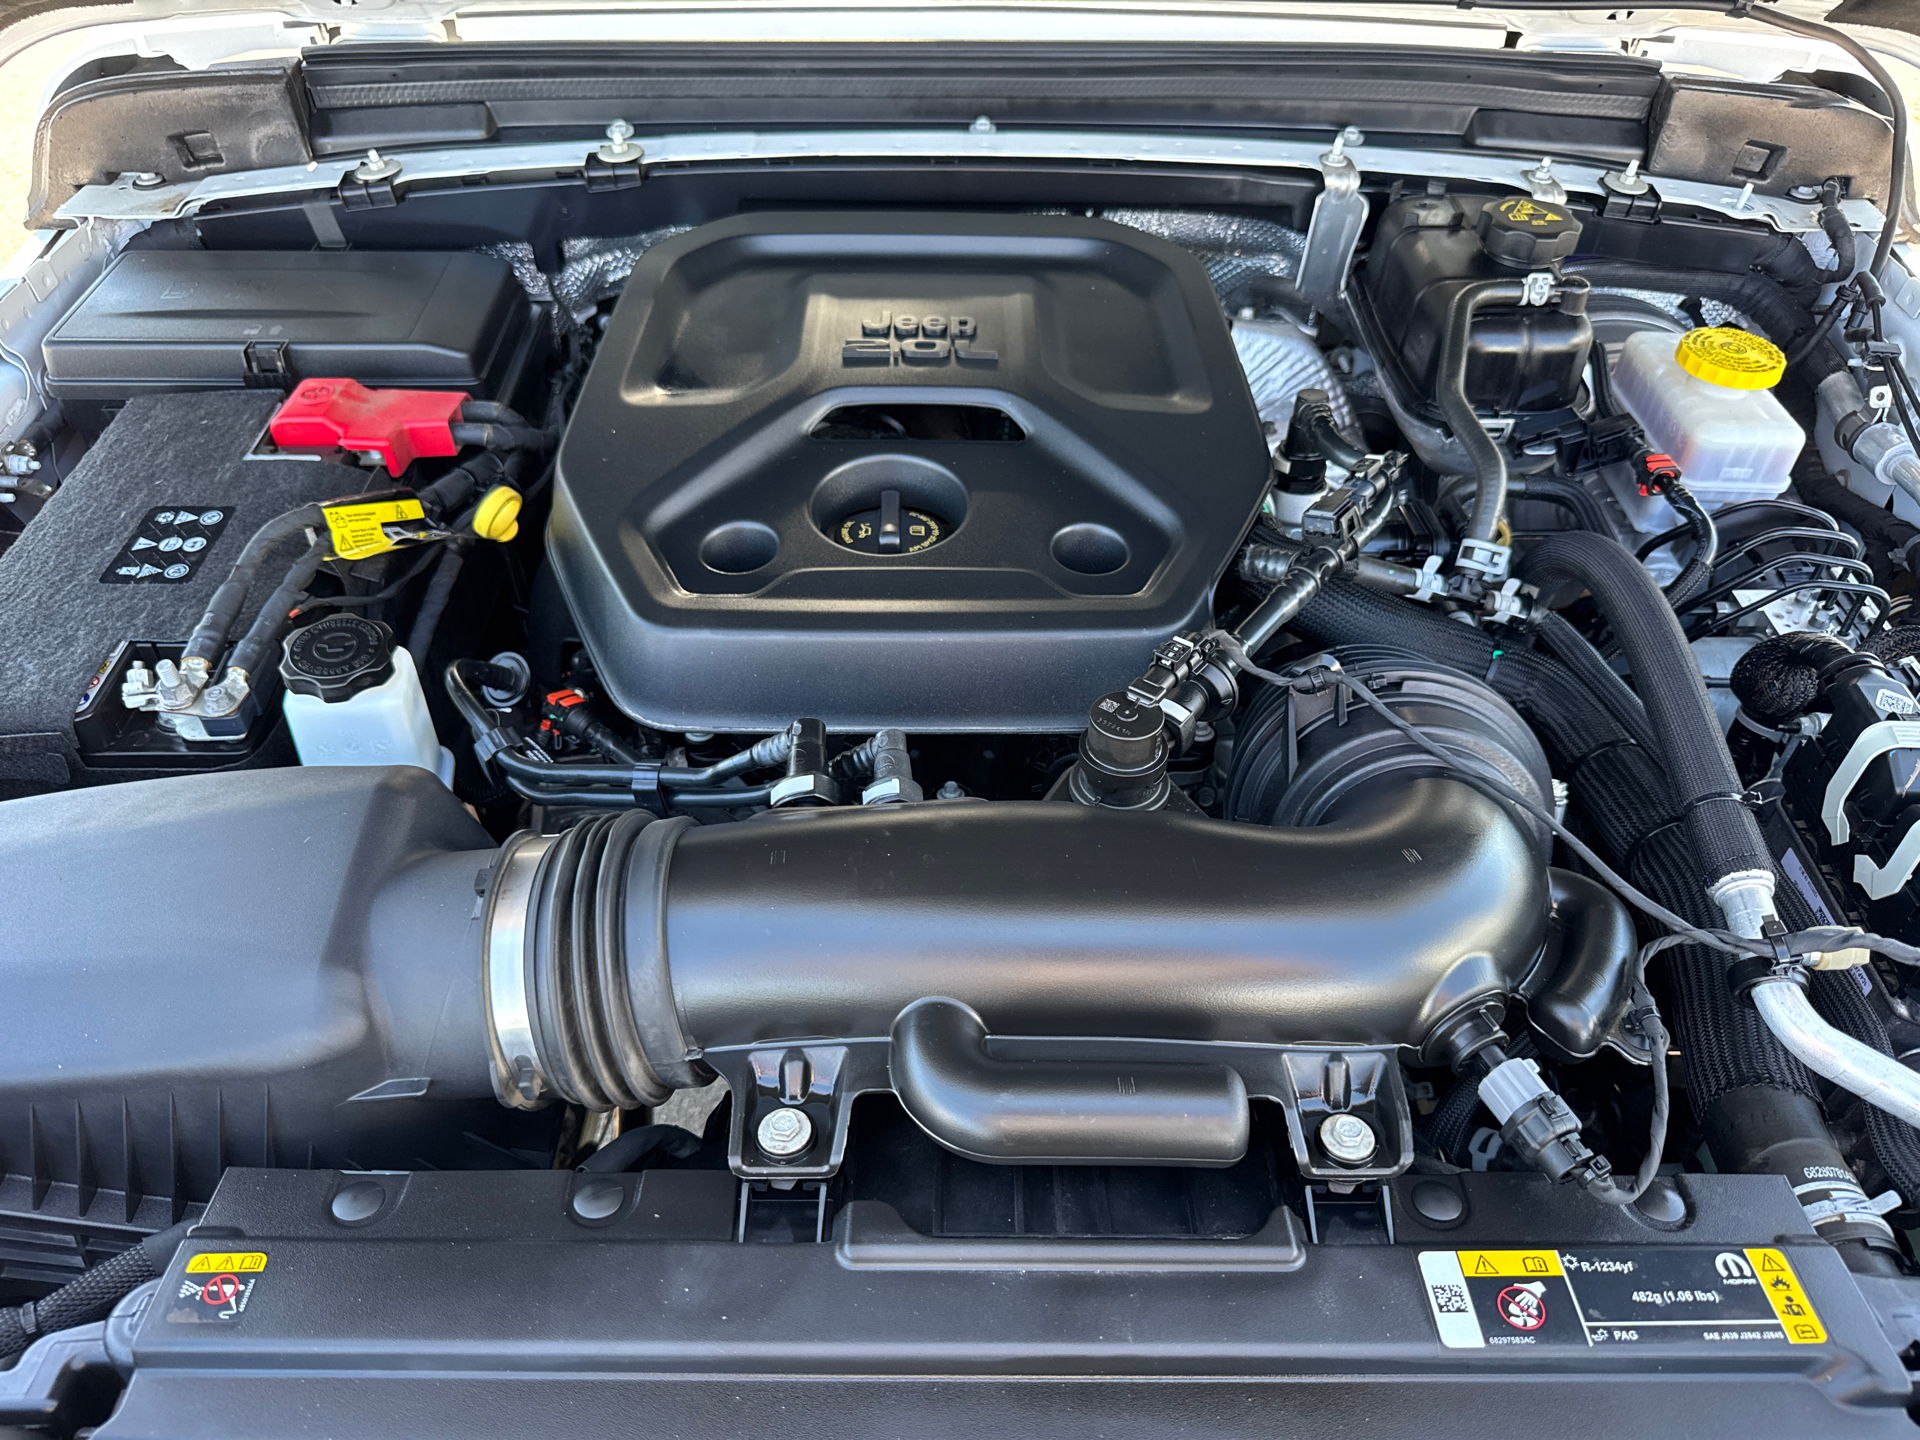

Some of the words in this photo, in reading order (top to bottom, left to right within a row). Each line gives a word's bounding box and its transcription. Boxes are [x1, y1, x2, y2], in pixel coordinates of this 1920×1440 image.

[862, 311, 977, 337] Jeep
[1580, 1261, 1634, 1274] R-1234yf
[1632, 1291, 1662, 1304] 482g
[1664, 1291, 1693, 1304] (1.06
[1695, 1290, 1720, 1304] lbs)
[1614, 1330, 1639, 1341] PAG
